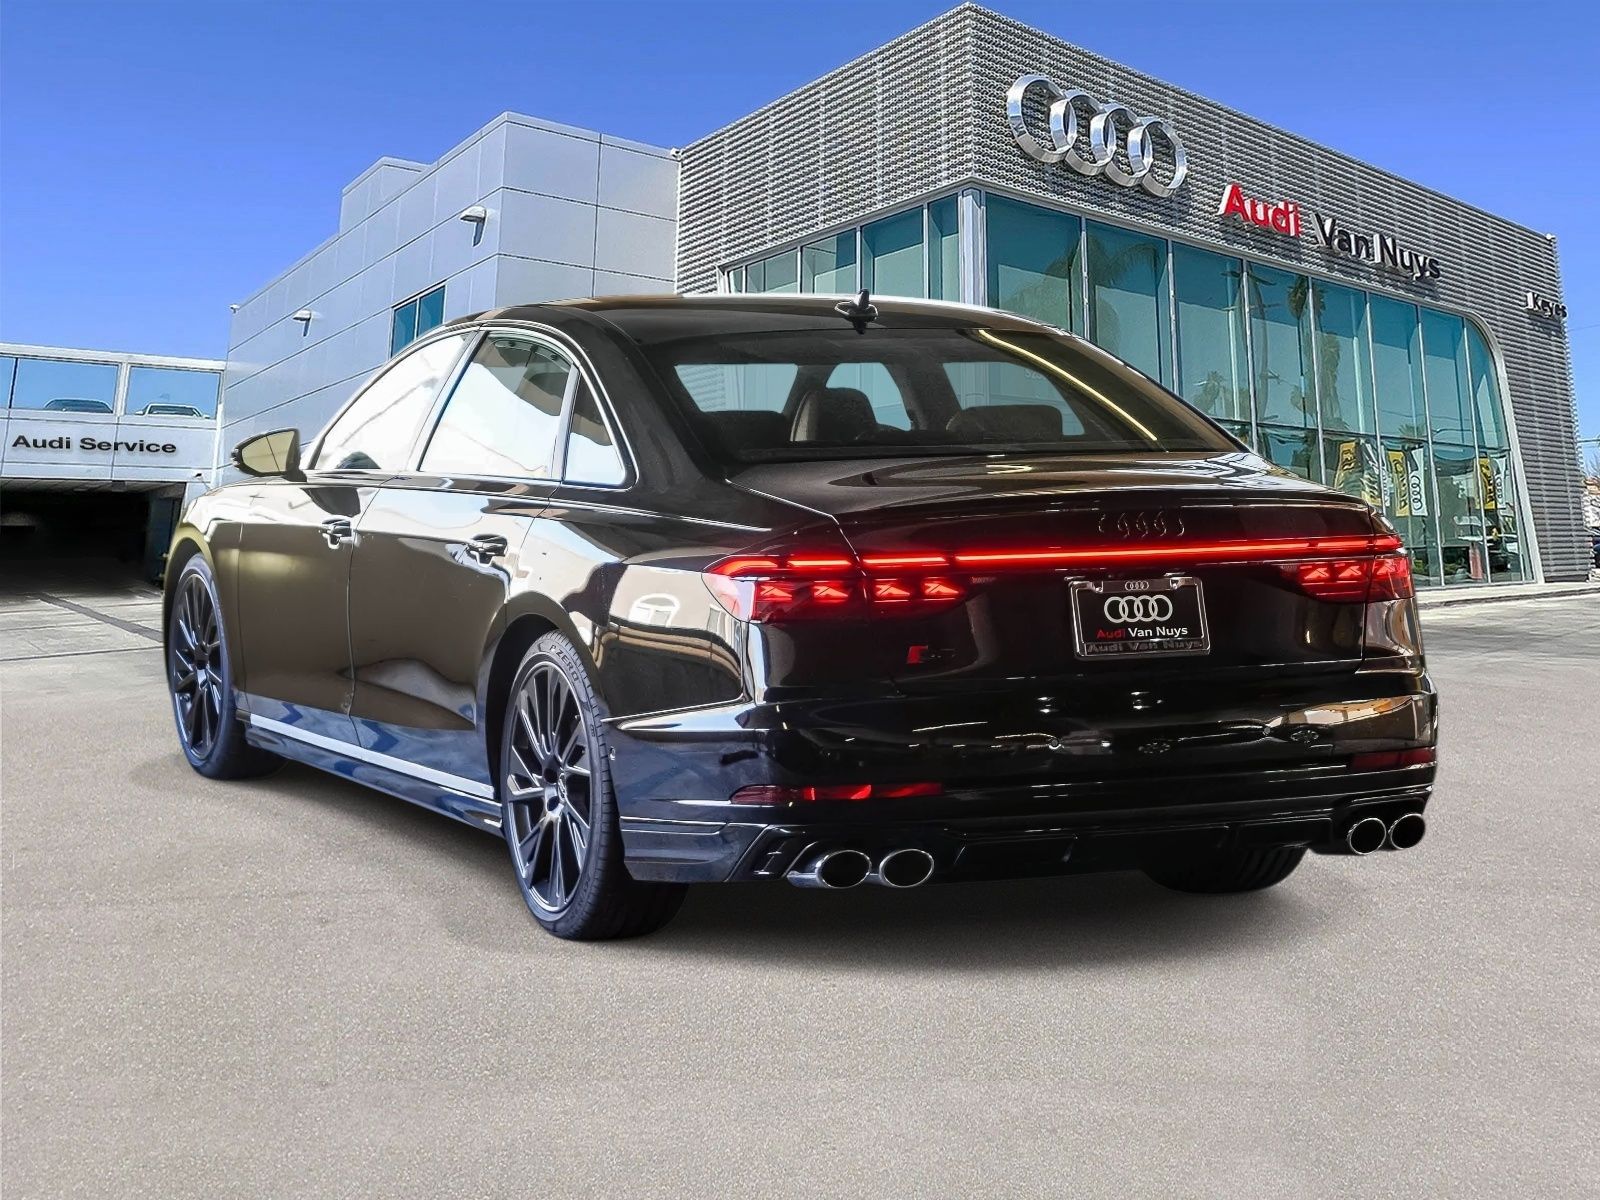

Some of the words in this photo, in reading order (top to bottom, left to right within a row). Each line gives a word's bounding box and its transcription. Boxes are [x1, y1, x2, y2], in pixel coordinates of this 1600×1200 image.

[1217, 182, 1302, 237] Audi
[1312, 212, 1369, 258] Van
[1374, 233, 1441, 280] Nuys
[12, 435, 71, 450] Audi
[80, 437, 177, 453] Service
[1096, 628, 1126, 639] Audi
[1128, 627, 1153, 637] Van
[1156, 626, 1188, 638] Nuys
